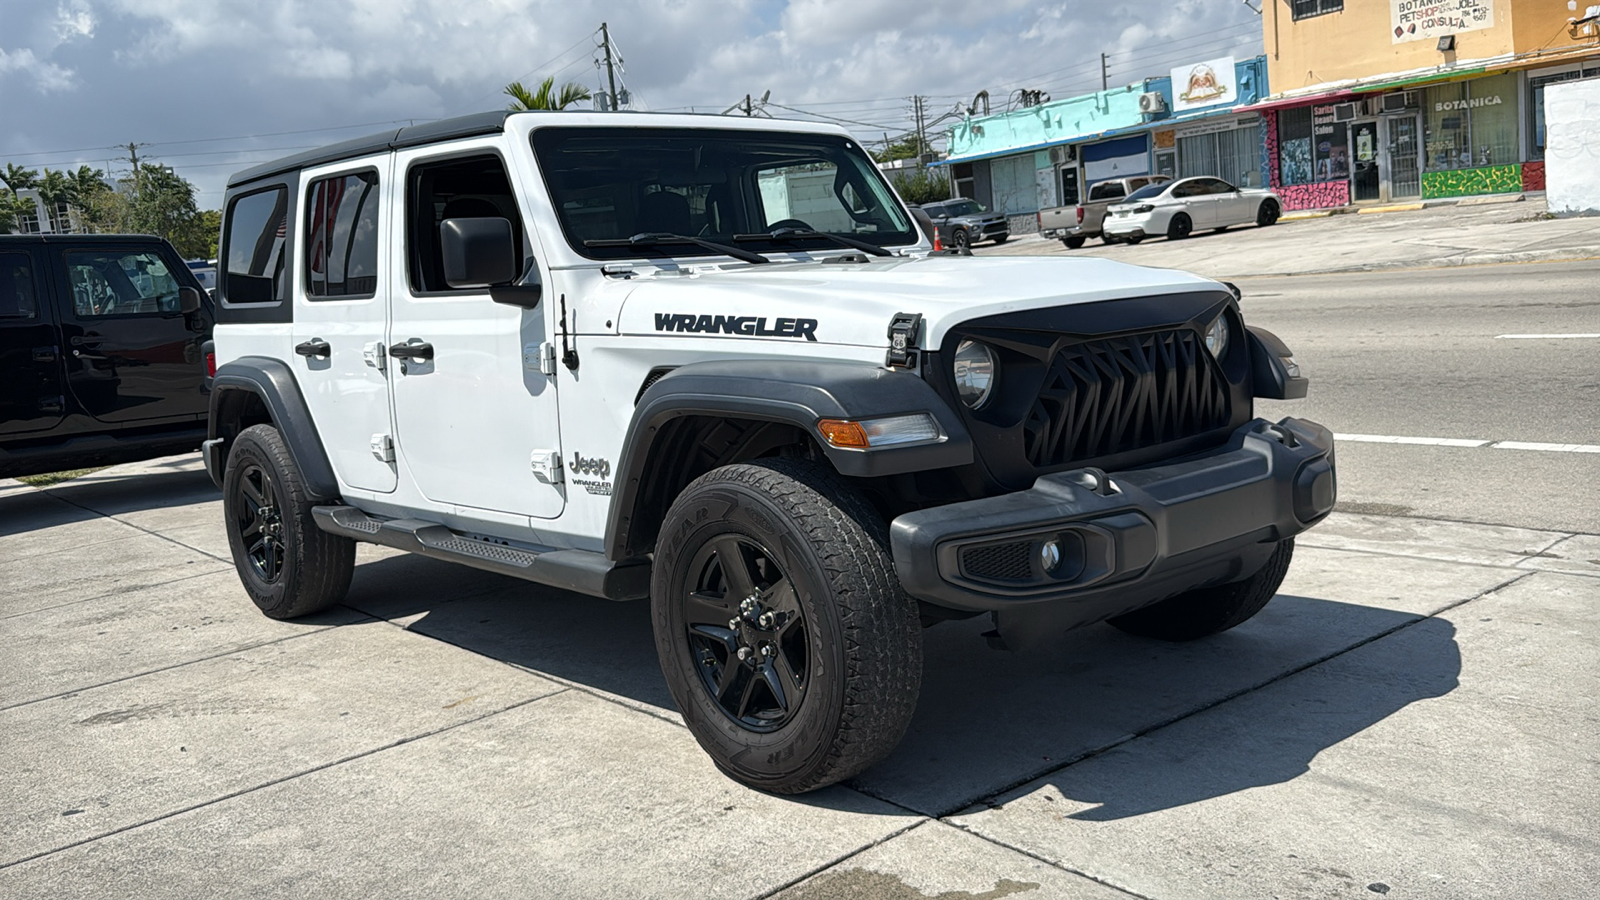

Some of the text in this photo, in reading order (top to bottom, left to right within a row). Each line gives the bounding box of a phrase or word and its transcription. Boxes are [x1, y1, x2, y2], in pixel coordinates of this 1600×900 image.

[1399, 0, 1447, 13] BOTAN
[1435, 95, 1502, 112] BOTANICA
[1315, 126, 1333, 135] Salon
[654, 313, 819, 342] WRANGLER
[894, 339, 904, 347] 66
[569, 452, 610, 480] Jeep
[572, 479, 612, 488] WRANGLER
